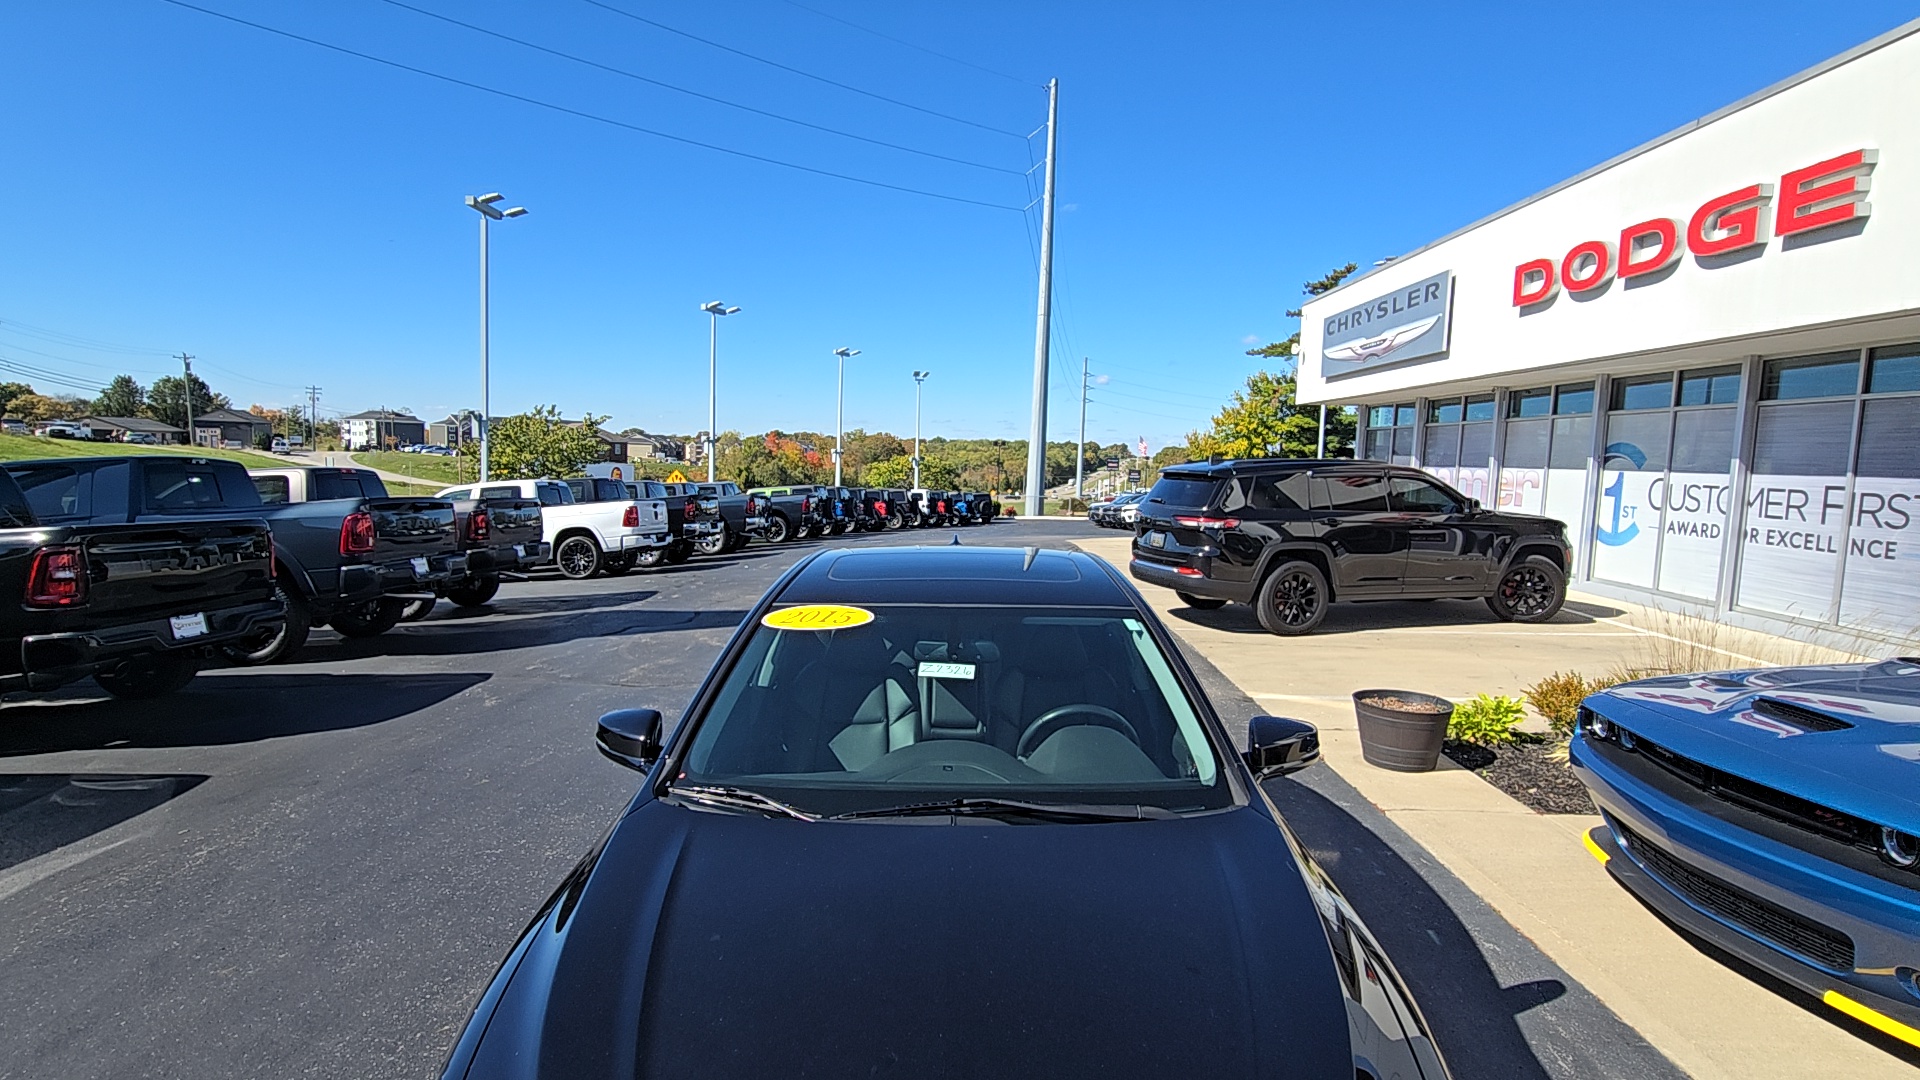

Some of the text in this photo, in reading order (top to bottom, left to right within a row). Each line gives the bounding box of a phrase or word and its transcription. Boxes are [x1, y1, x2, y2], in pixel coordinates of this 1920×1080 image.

[1512, 148, 1875, 307] DODGE
[1326, 282, 1440, 336] CHRYSLER
[1820, 485, 1920, 530] FIRS
[1666, 520, 1721, 540] AWARD
[1765, 529, 1898, 561] EXCELLNCE
[151, 553, 234, 573] RAM
[780, 610, 857, 624] 2015
